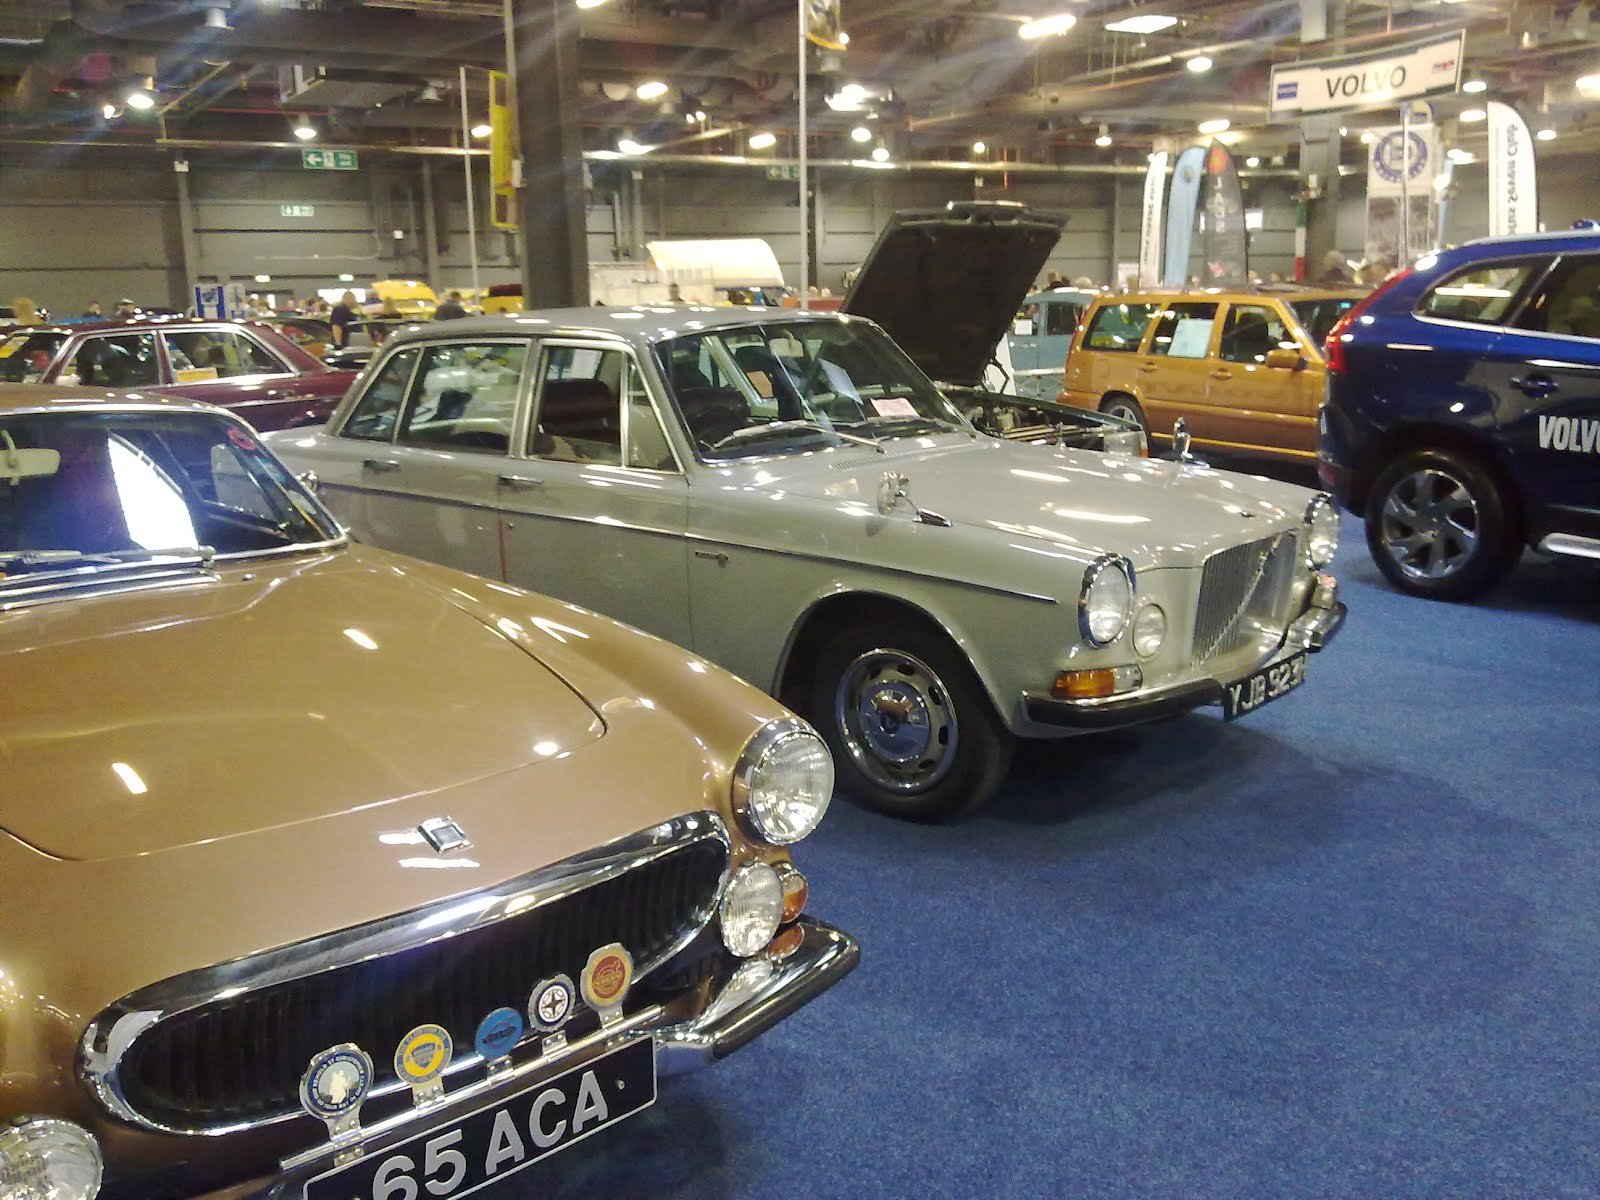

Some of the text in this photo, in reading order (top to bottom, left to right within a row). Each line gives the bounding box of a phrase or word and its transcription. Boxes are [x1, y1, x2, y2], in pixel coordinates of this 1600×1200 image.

[1326, 66, 1406, 98] VOLVO
[1229, 675, 1266, 715] YJB
[372, 1070, 609, 1200] 65 ACA
